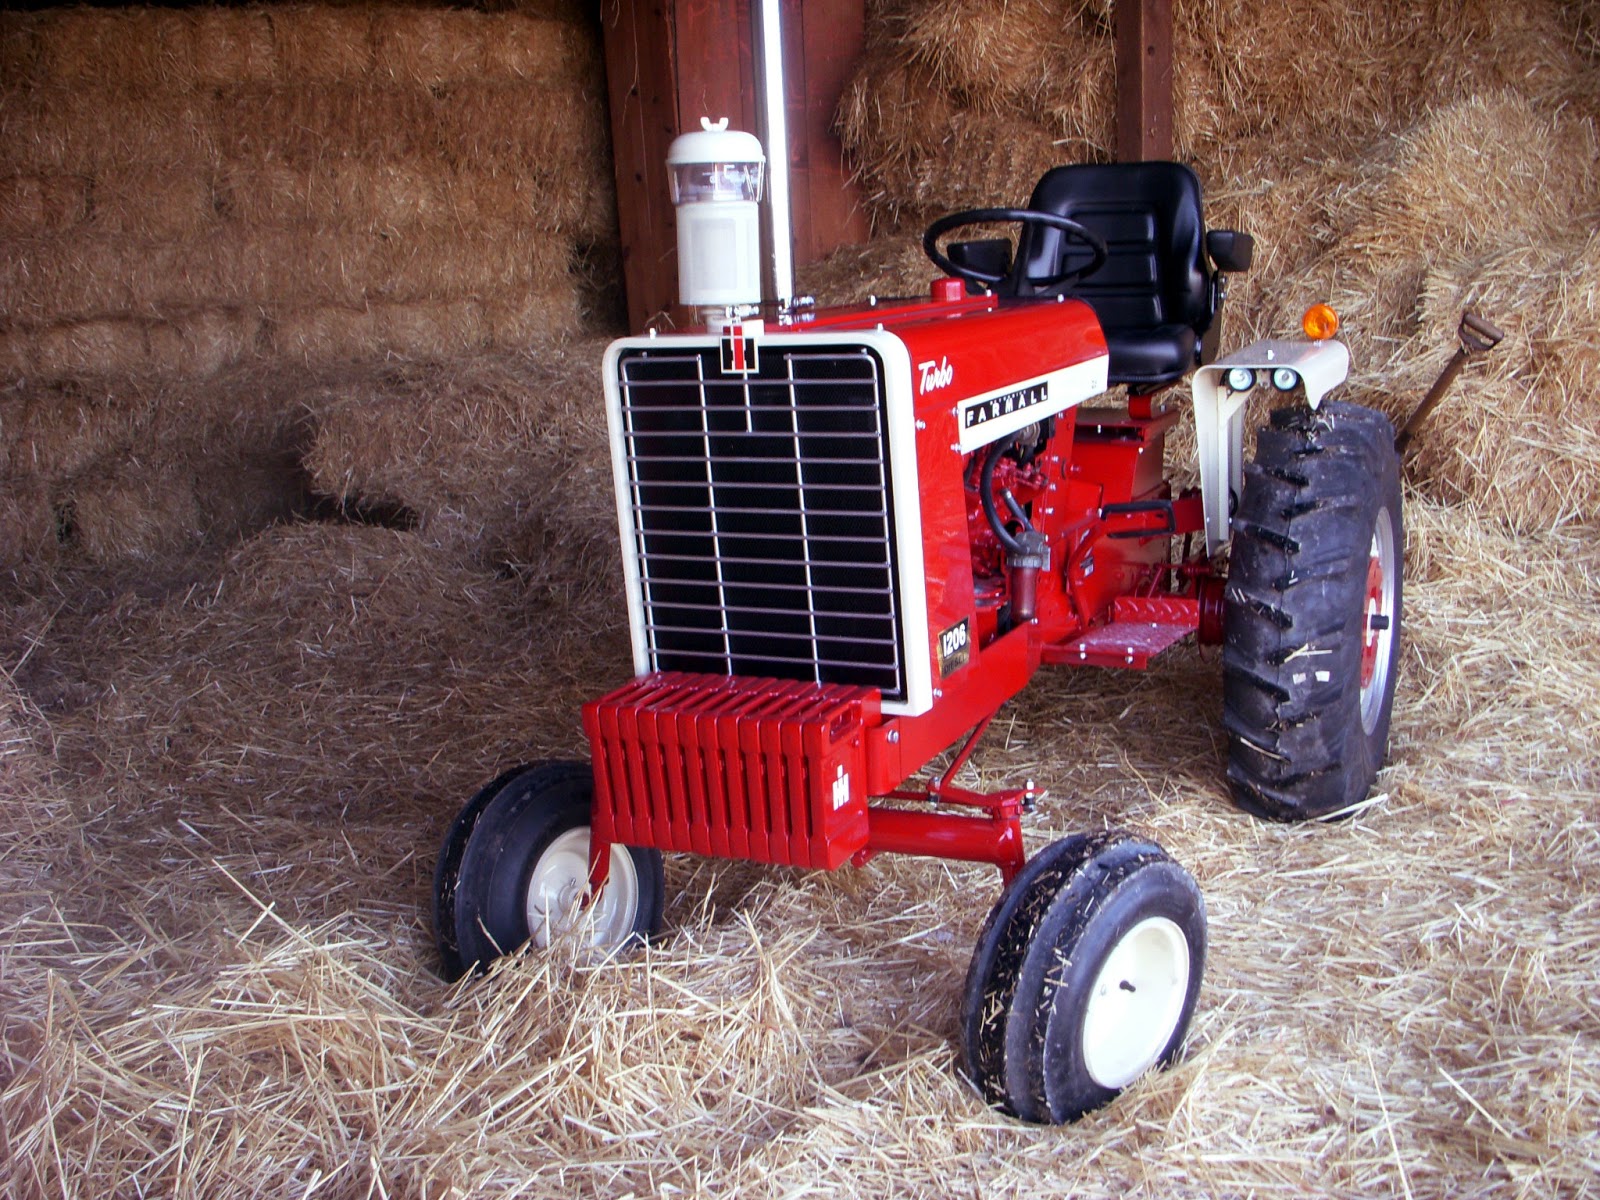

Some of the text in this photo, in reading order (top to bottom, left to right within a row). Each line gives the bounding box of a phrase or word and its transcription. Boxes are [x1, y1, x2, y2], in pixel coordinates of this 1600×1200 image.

[918, 355, 953, 396] Turbo
[967, 386, 1047, 427] FARMALL
[943, 623, 966, 657] 1206
